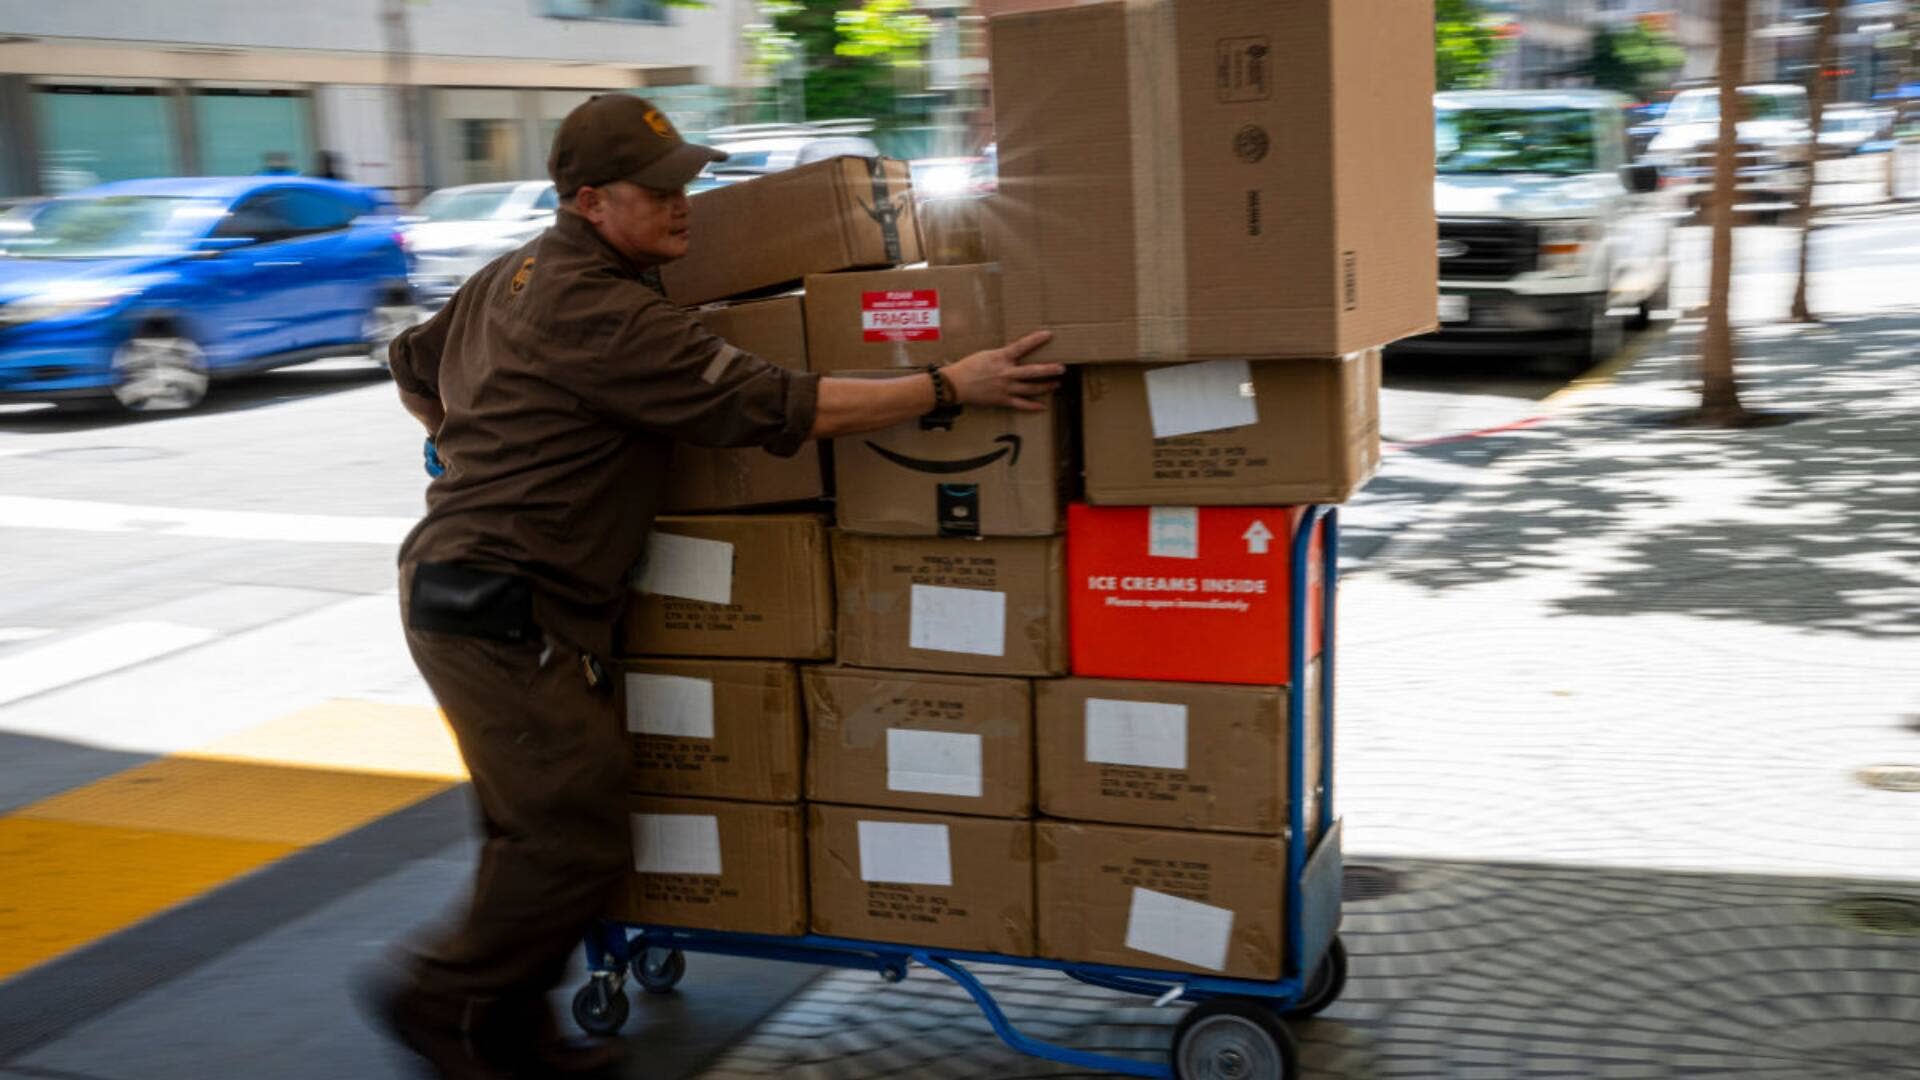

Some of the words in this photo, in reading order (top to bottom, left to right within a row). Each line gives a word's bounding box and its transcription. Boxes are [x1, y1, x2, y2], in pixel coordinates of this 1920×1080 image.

[872, 311, 929, 326] FRAGILE
[1088, 576, 1117, 590] ICE
[1121, 577, 1198, 592] CREAMS
[1202, 579, 1267, 594] INSIDE
